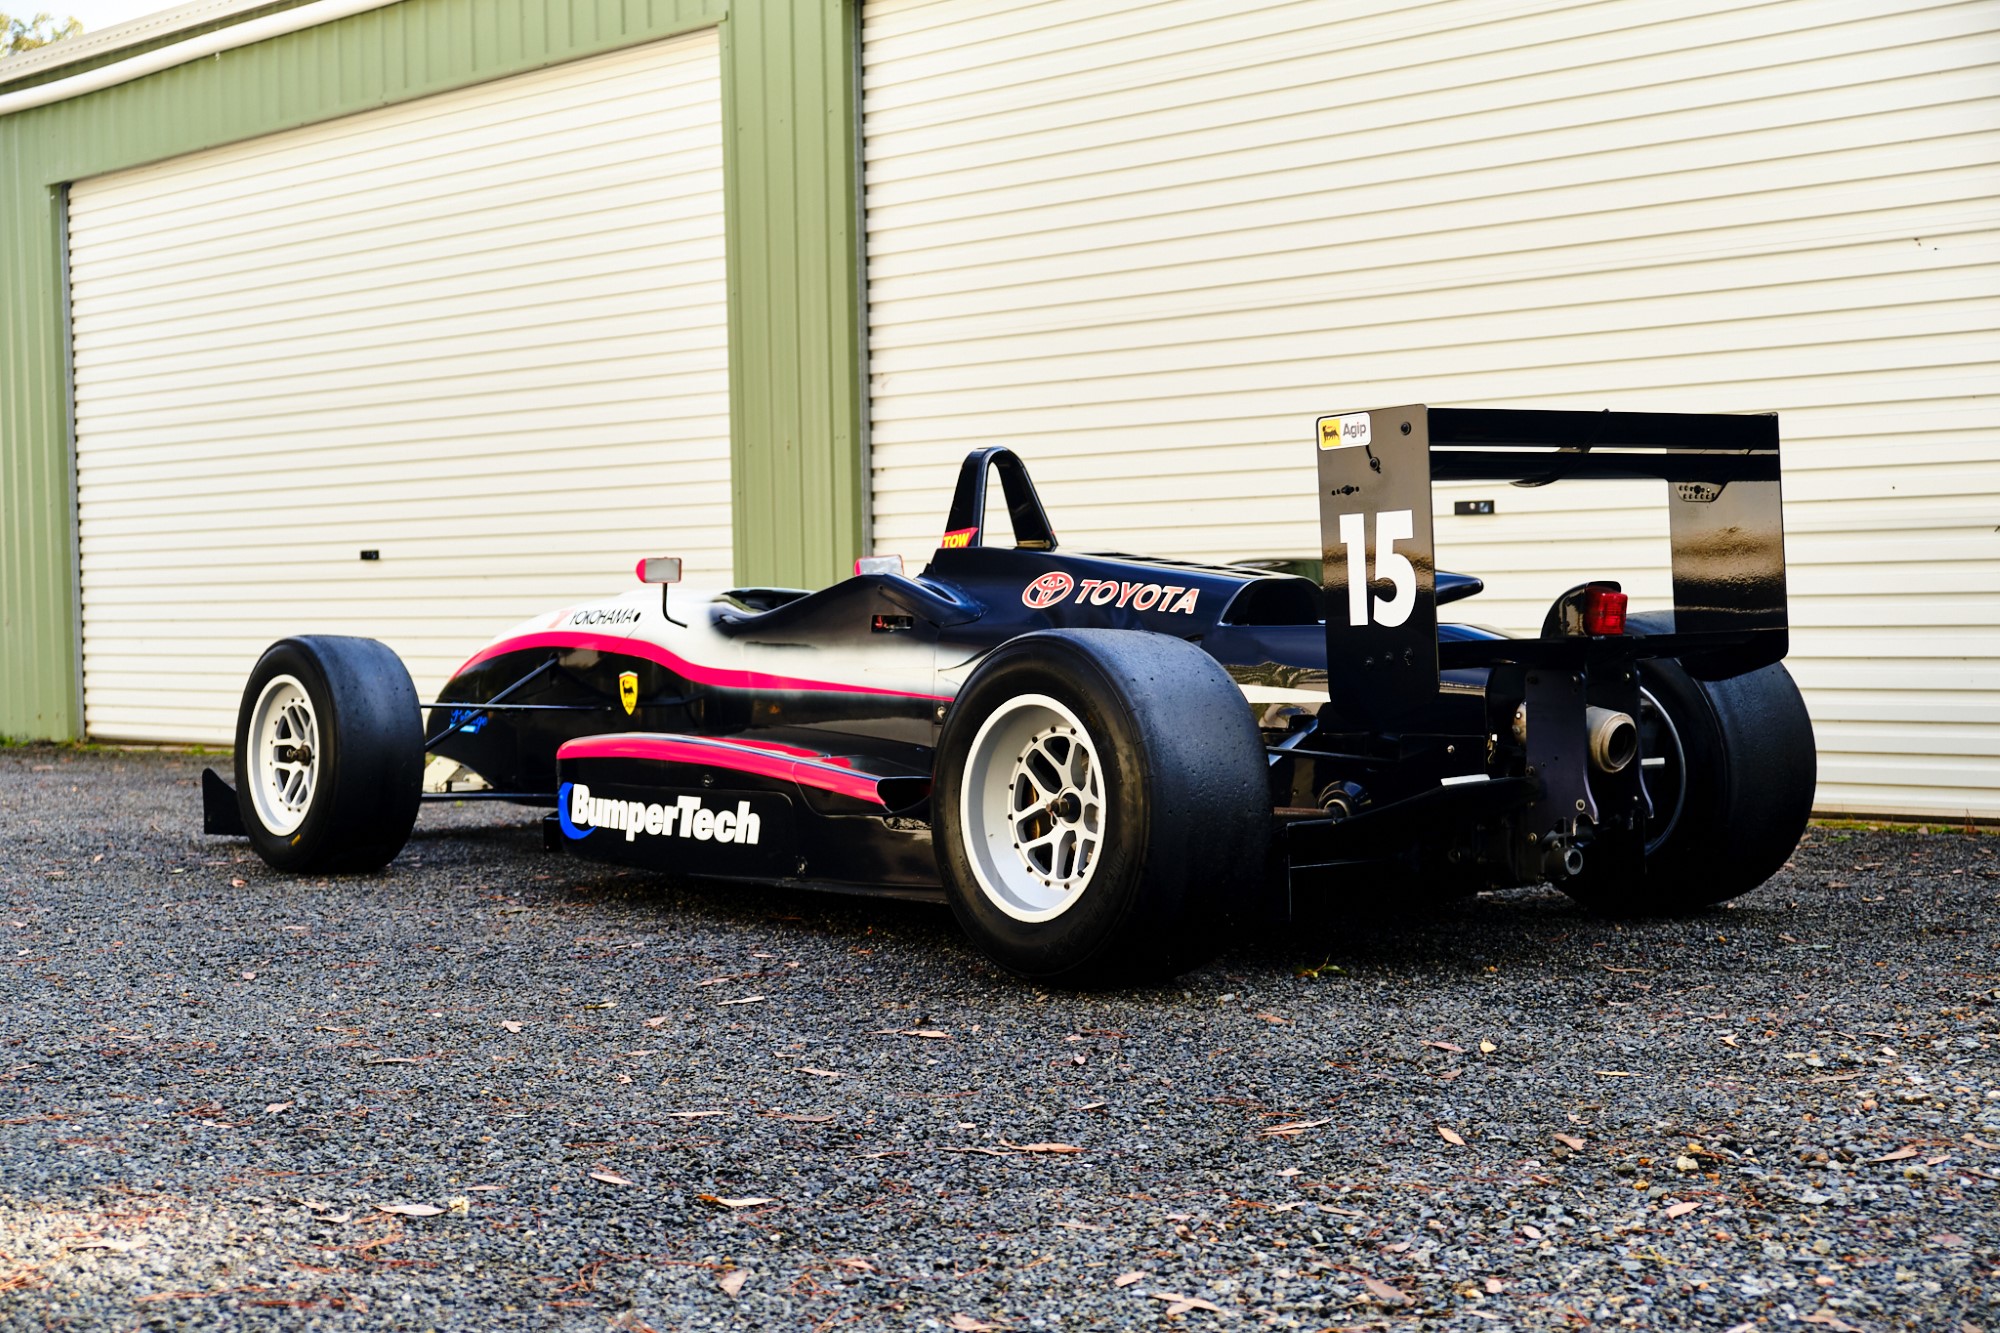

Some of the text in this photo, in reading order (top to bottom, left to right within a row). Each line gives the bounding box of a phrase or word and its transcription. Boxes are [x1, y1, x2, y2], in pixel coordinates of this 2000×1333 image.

[1343, 421, 1367, 438] Agip
[943, 532, 970, 548] TOW
[1339, 509, 1417, 628] 15
[1074, 579, 1200, 615] TOYOTA
[569, 608, 636, 625] YOKOHAMA
[571, 783, 761, 845] BumperTech
